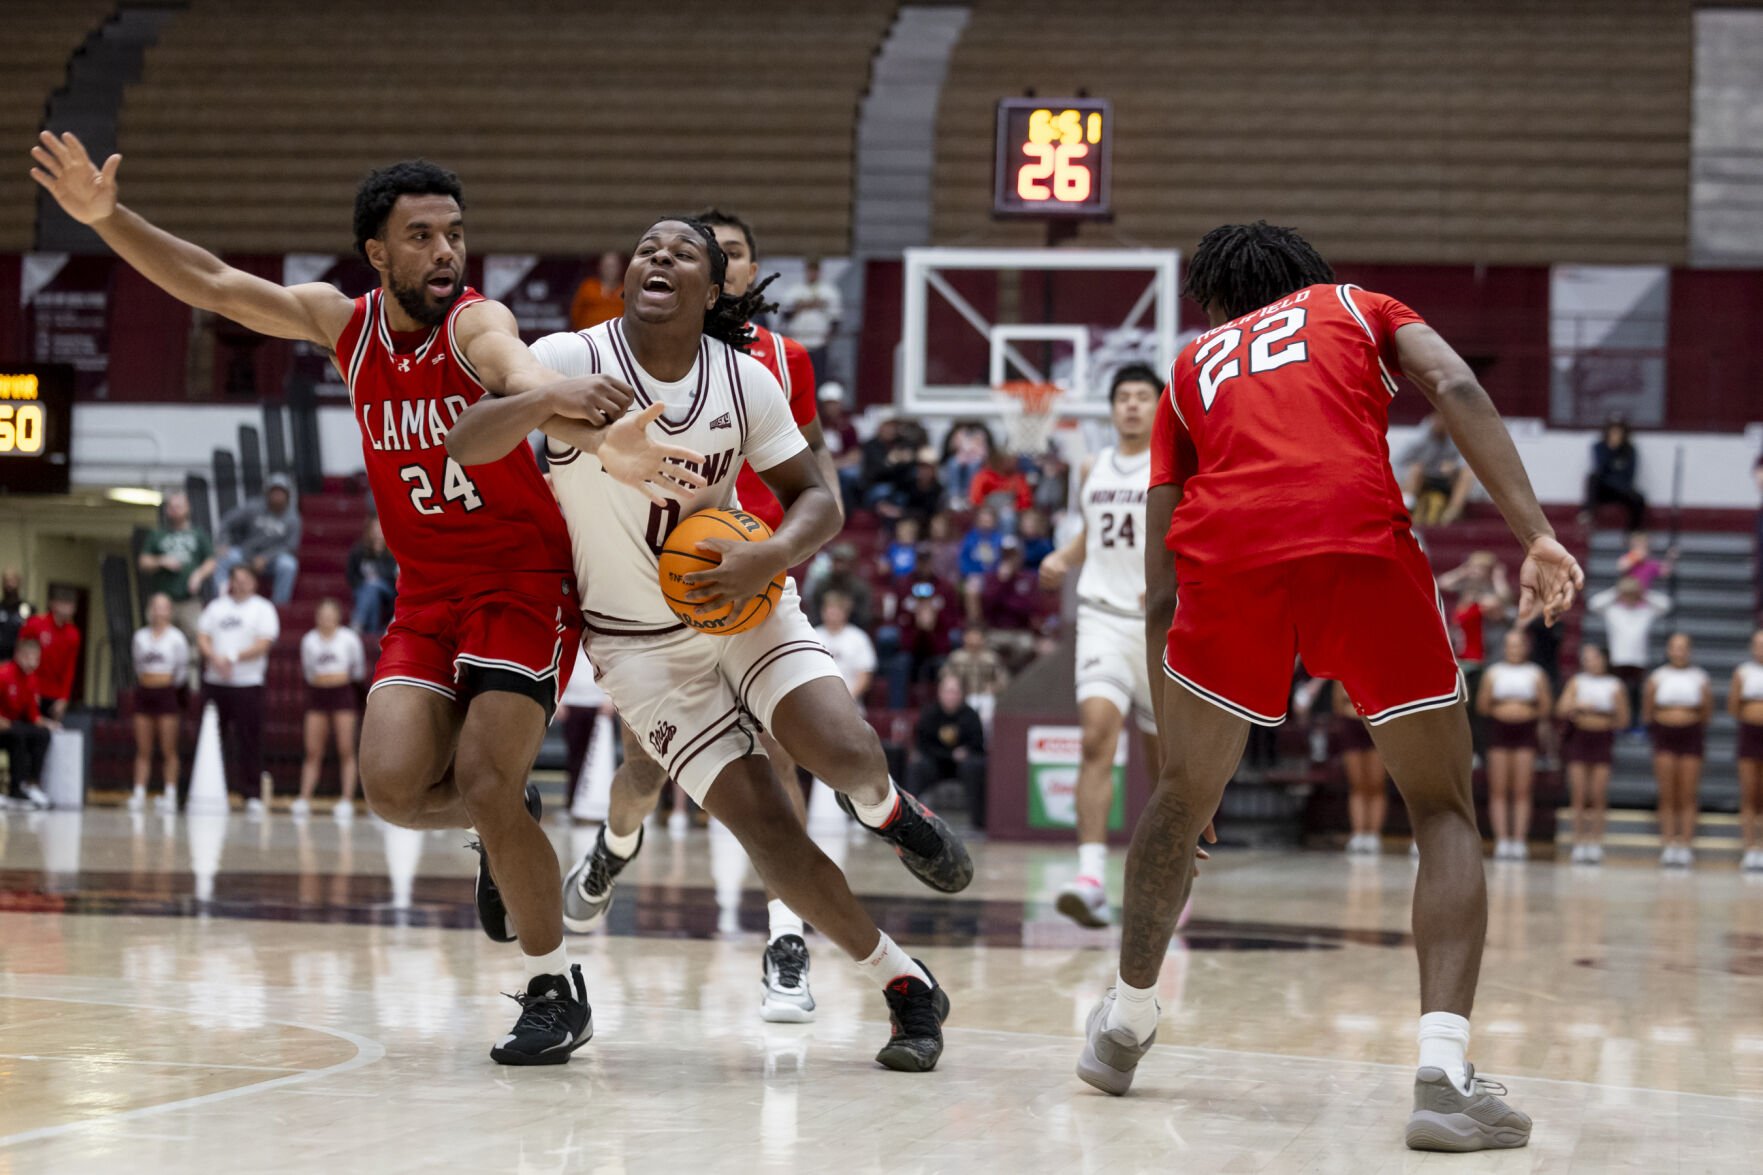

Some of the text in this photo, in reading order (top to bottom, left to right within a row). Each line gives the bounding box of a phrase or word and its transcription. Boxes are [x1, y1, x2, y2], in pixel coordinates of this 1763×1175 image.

[1018, 142, 1090, 202] 26
[1193, 306, 1309, 416] 22
[400, 456, 484, 515] 24
[1089, 489, 1147, 505] MONTAN
[1100, 511, 1136, 549] 24
